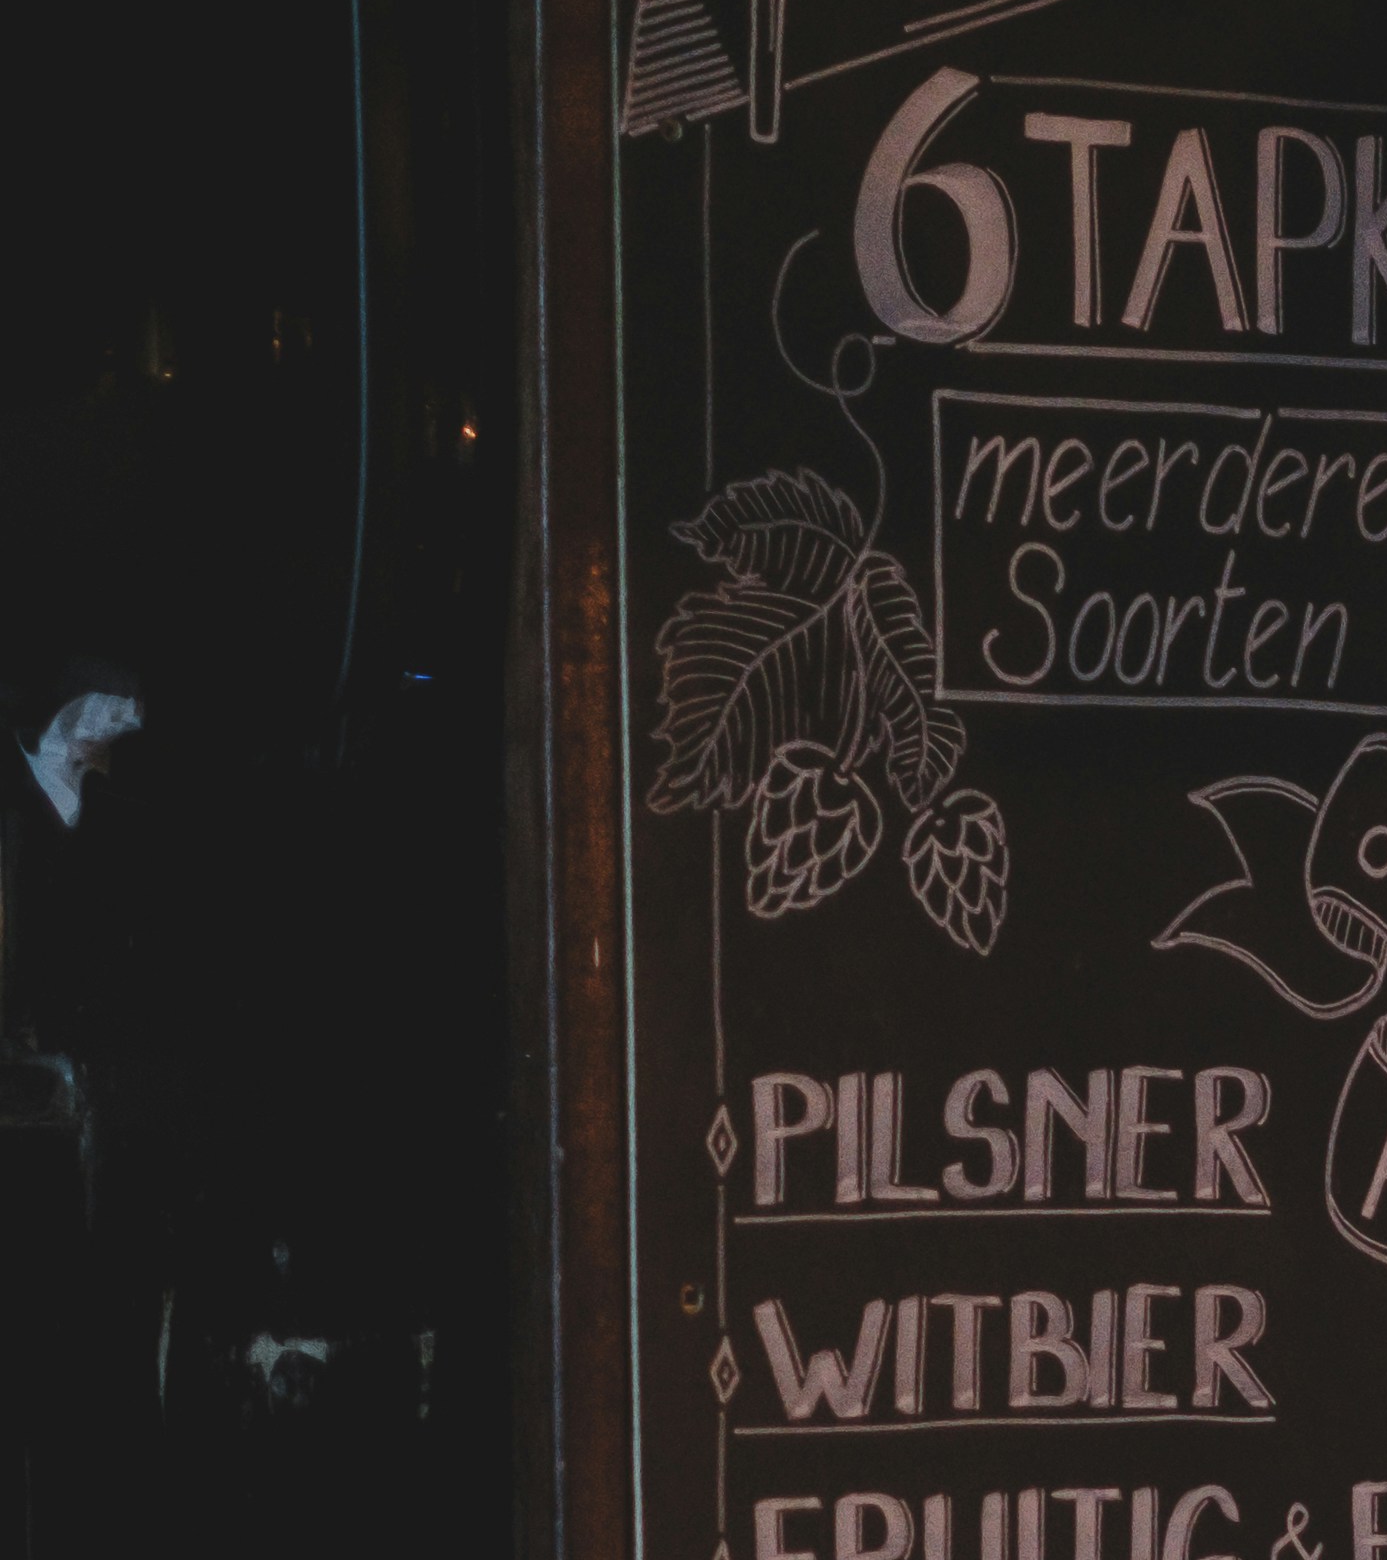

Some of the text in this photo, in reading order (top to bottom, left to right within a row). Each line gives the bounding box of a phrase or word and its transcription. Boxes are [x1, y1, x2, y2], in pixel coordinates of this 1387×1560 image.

[851, 65, 1019, 344] 6
[982, 542, 1349, 690] Soorten
[751, 1064, 1273, 1208] PILSNER
[752, 1282, 1278, 1421] WITBIER
